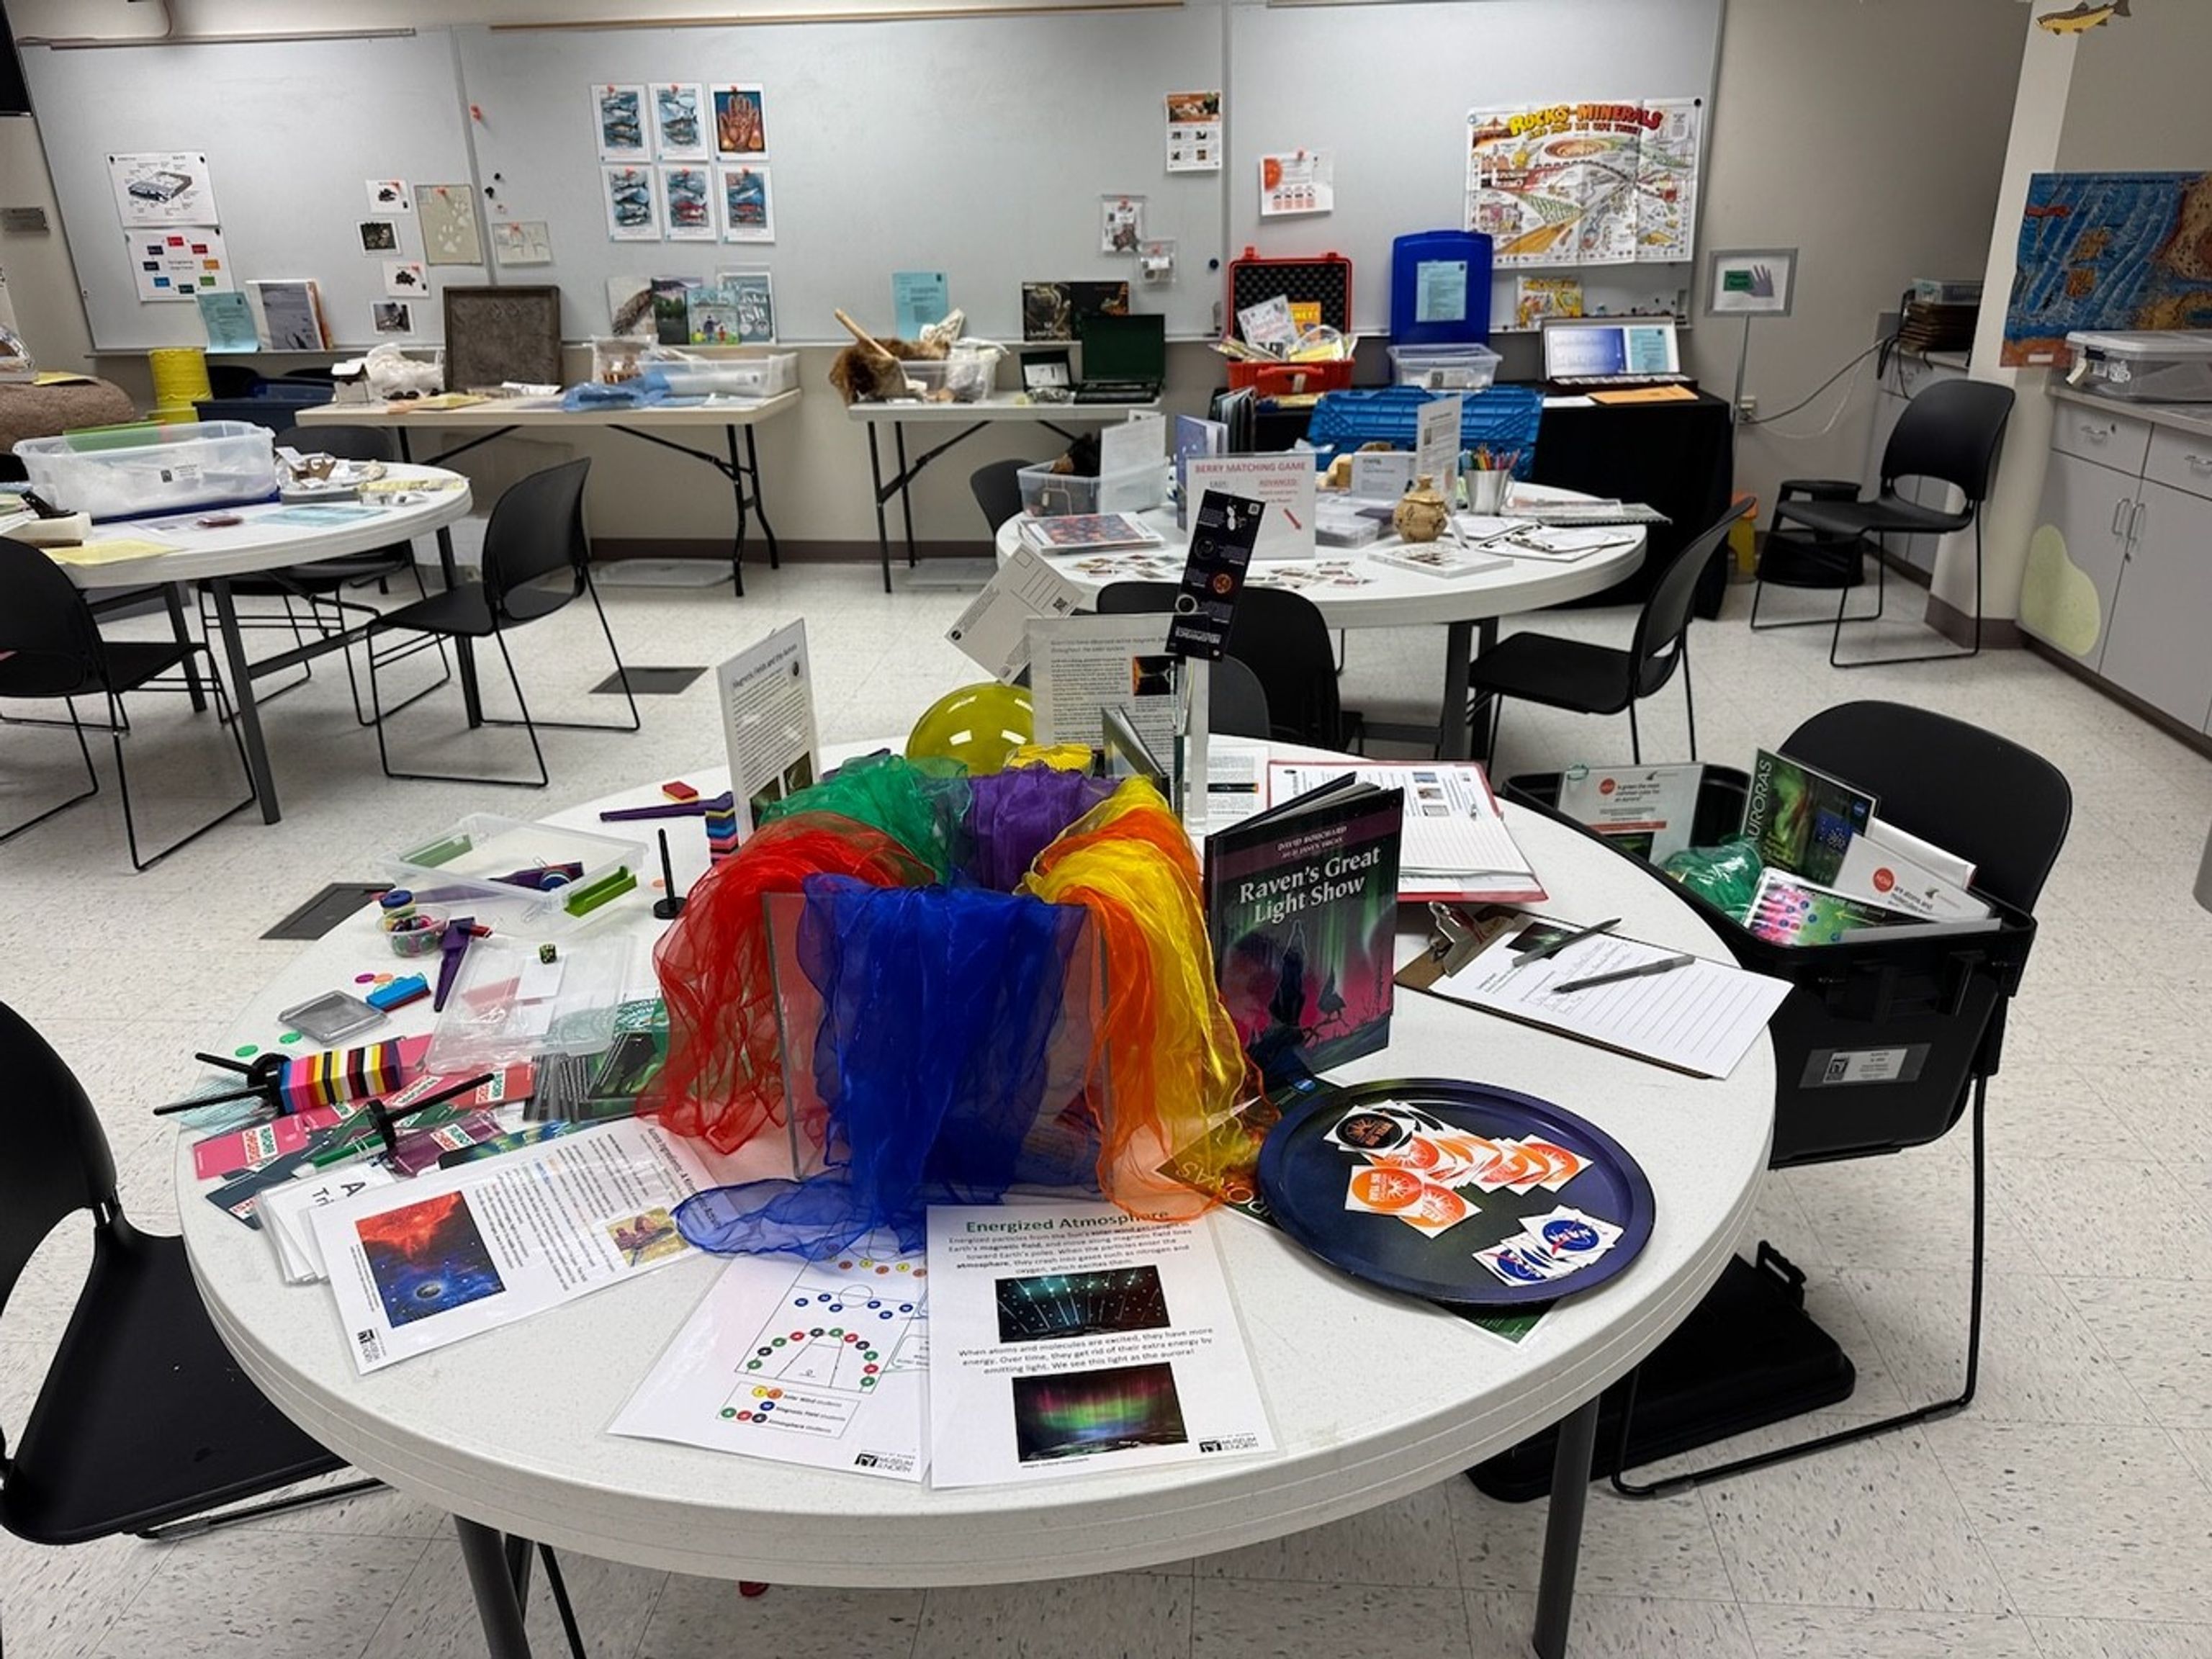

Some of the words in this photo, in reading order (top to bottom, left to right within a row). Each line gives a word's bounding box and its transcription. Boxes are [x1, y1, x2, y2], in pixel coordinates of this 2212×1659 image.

[1195, 464, 1225, 473] BERRY
[1226, 462, 1275, 472] MATCHING
[1277, 462, 1306, 471] GAME
[1240, 866, 1320, 904] Raven's
[1324, 847, 1381, 877] Great
[1254, 891, 1306, 925] Light
[1310, 876, 1365, 907] Show
[967, 1218, 1053, 1233] Energized
[1549, 1227, 1592, 1242] NASA
[1040, 1341, 1086, 1350] molecules
[1074, 1349, 1089, 1359] get
[1167, 1339, 1198, 1347] energy
[984, 1366, 1024, 1375] emitting
[1107, 1354, 1128, 1363] light
